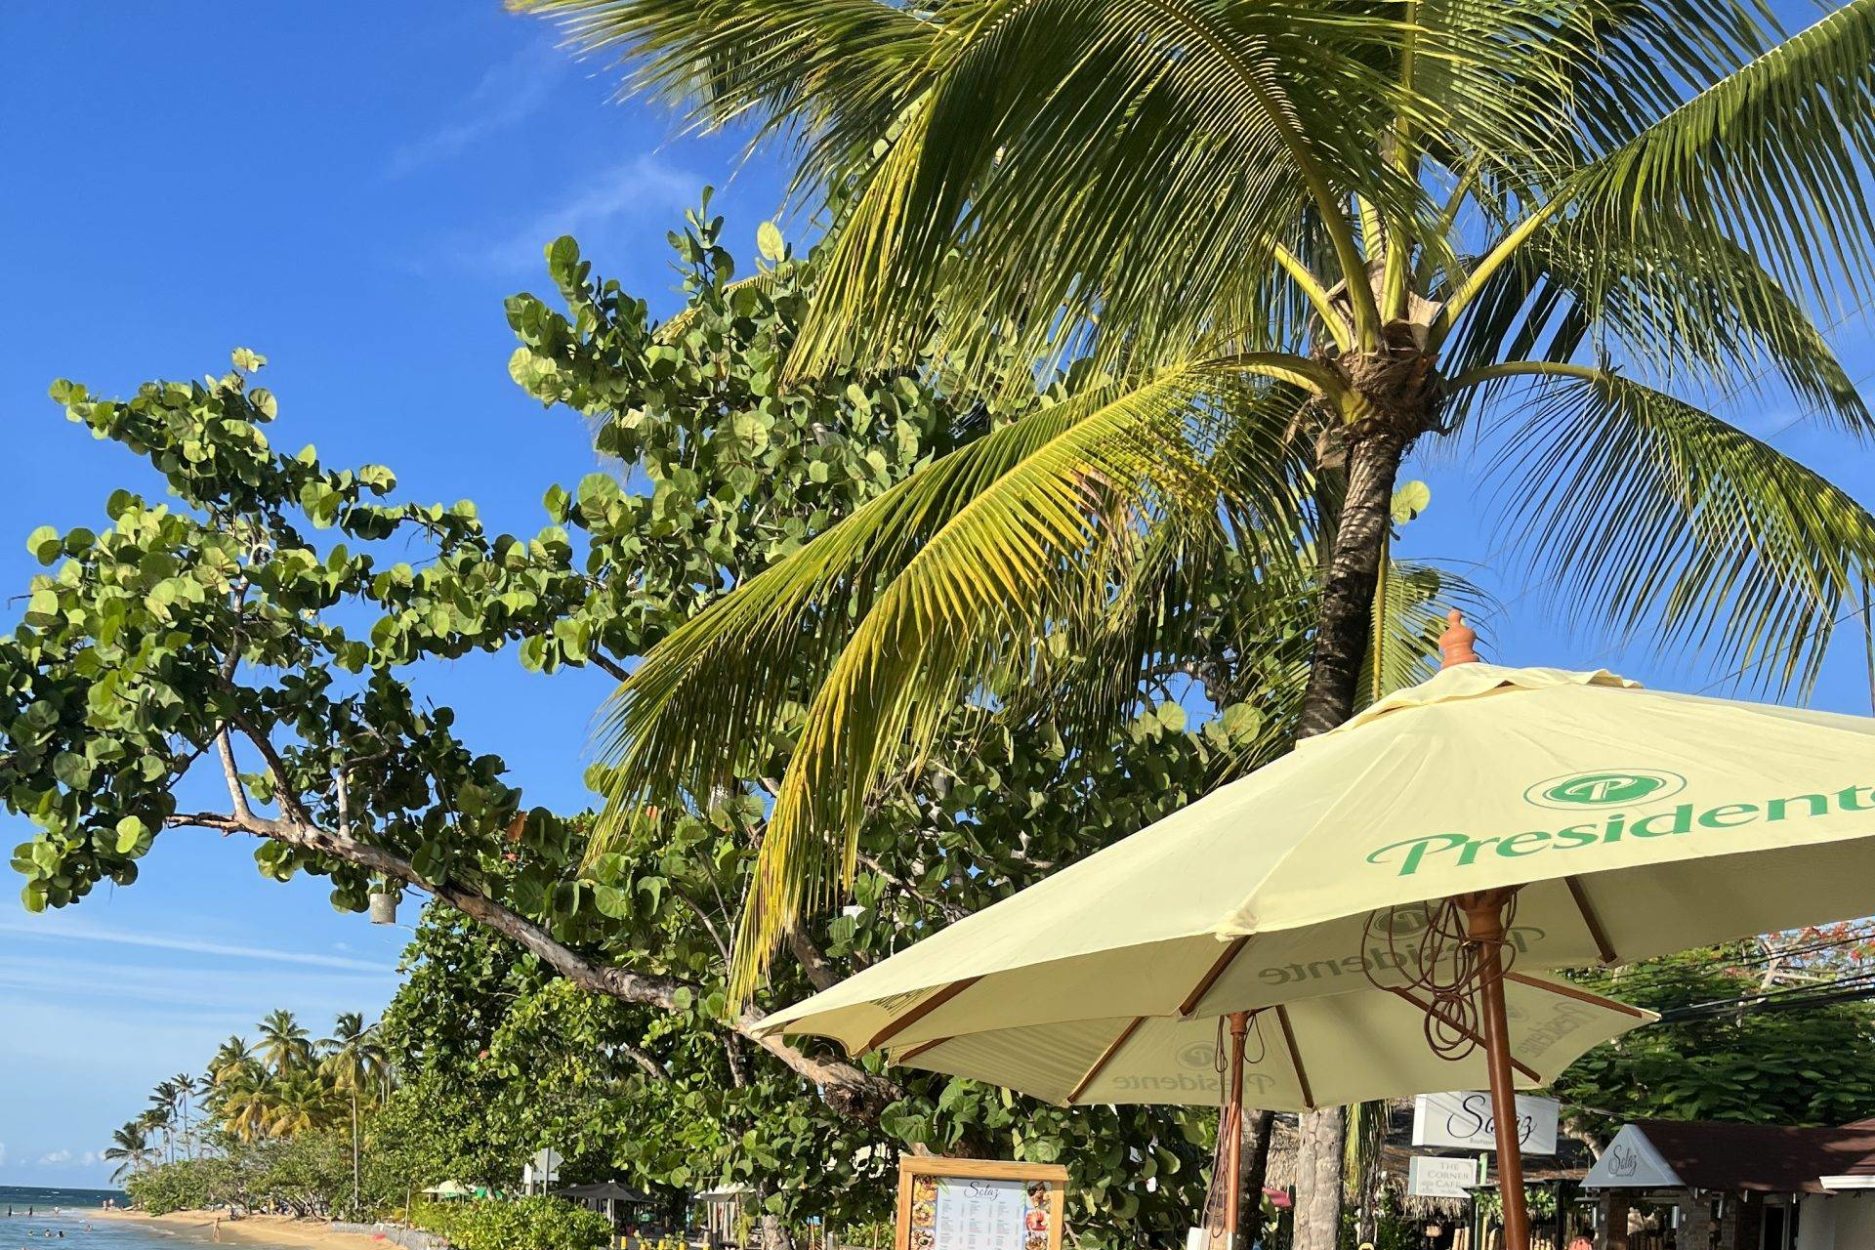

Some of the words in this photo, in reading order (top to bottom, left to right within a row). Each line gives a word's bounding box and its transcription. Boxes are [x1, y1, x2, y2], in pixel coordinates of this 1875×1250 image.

[1366, 785, 1875, 877] President
[1440, 1162, 1458, 1170] THE
[1428, 1170, 1469, 1180] CORNER
